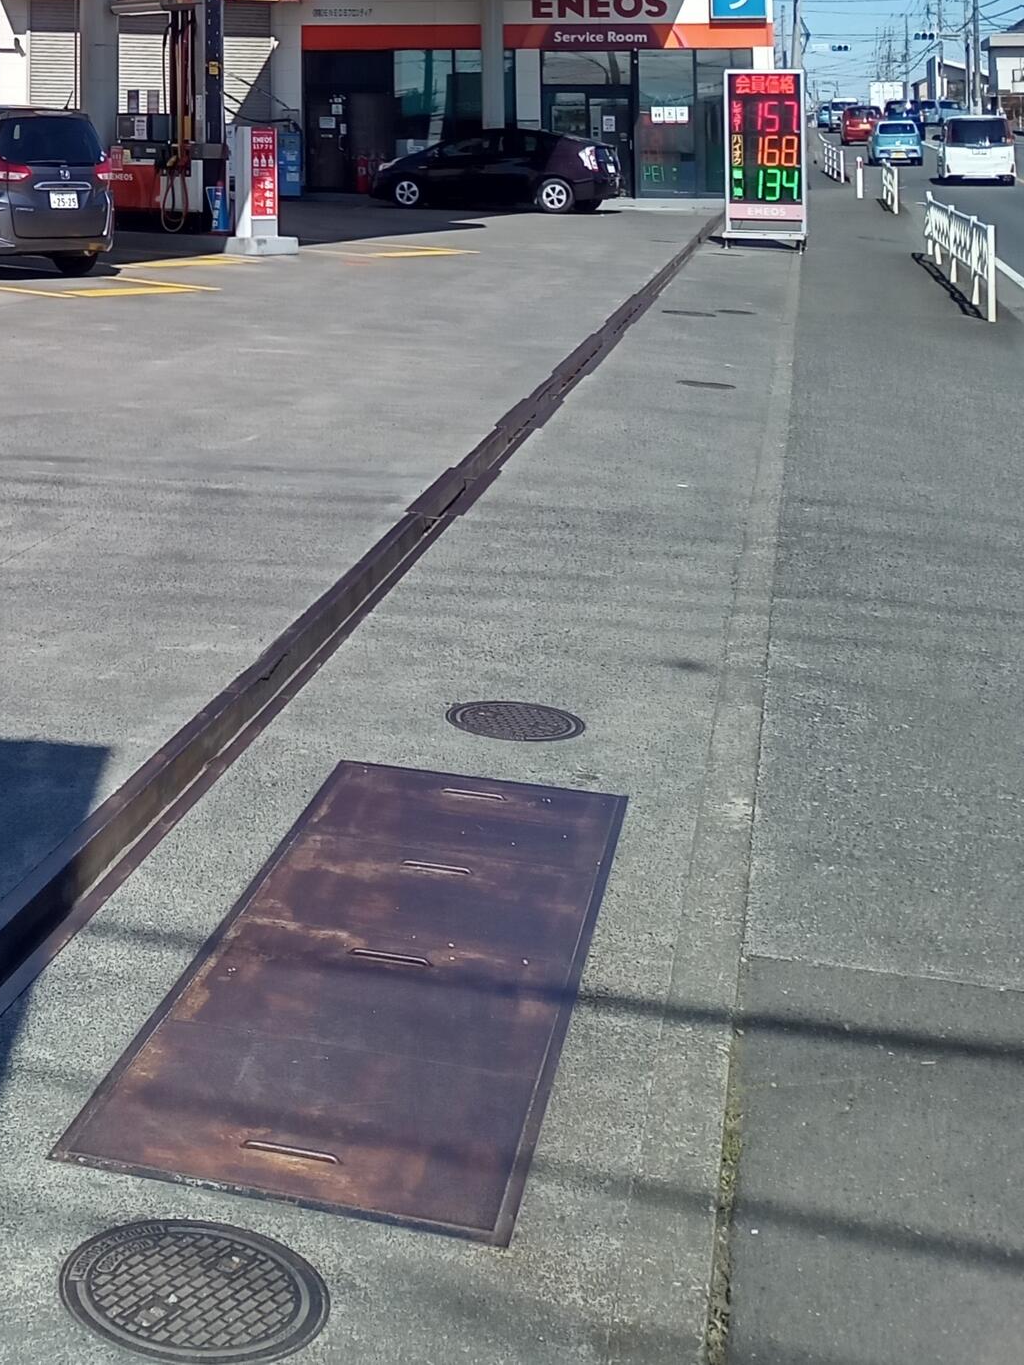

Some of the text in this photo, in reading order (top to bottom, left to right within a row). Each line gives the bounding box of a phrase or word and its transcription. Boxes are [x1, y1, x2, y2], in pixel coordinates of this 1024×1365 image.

[554, 31, 648, 43] Service Room
[735, 75, 794, 94] 会員価格
[757, 101, 798, 132] 157
[757, 136, 798, 166] 168
[757, 169, 799, 200] 134
[747, 207, 787, 217] ENEOS
